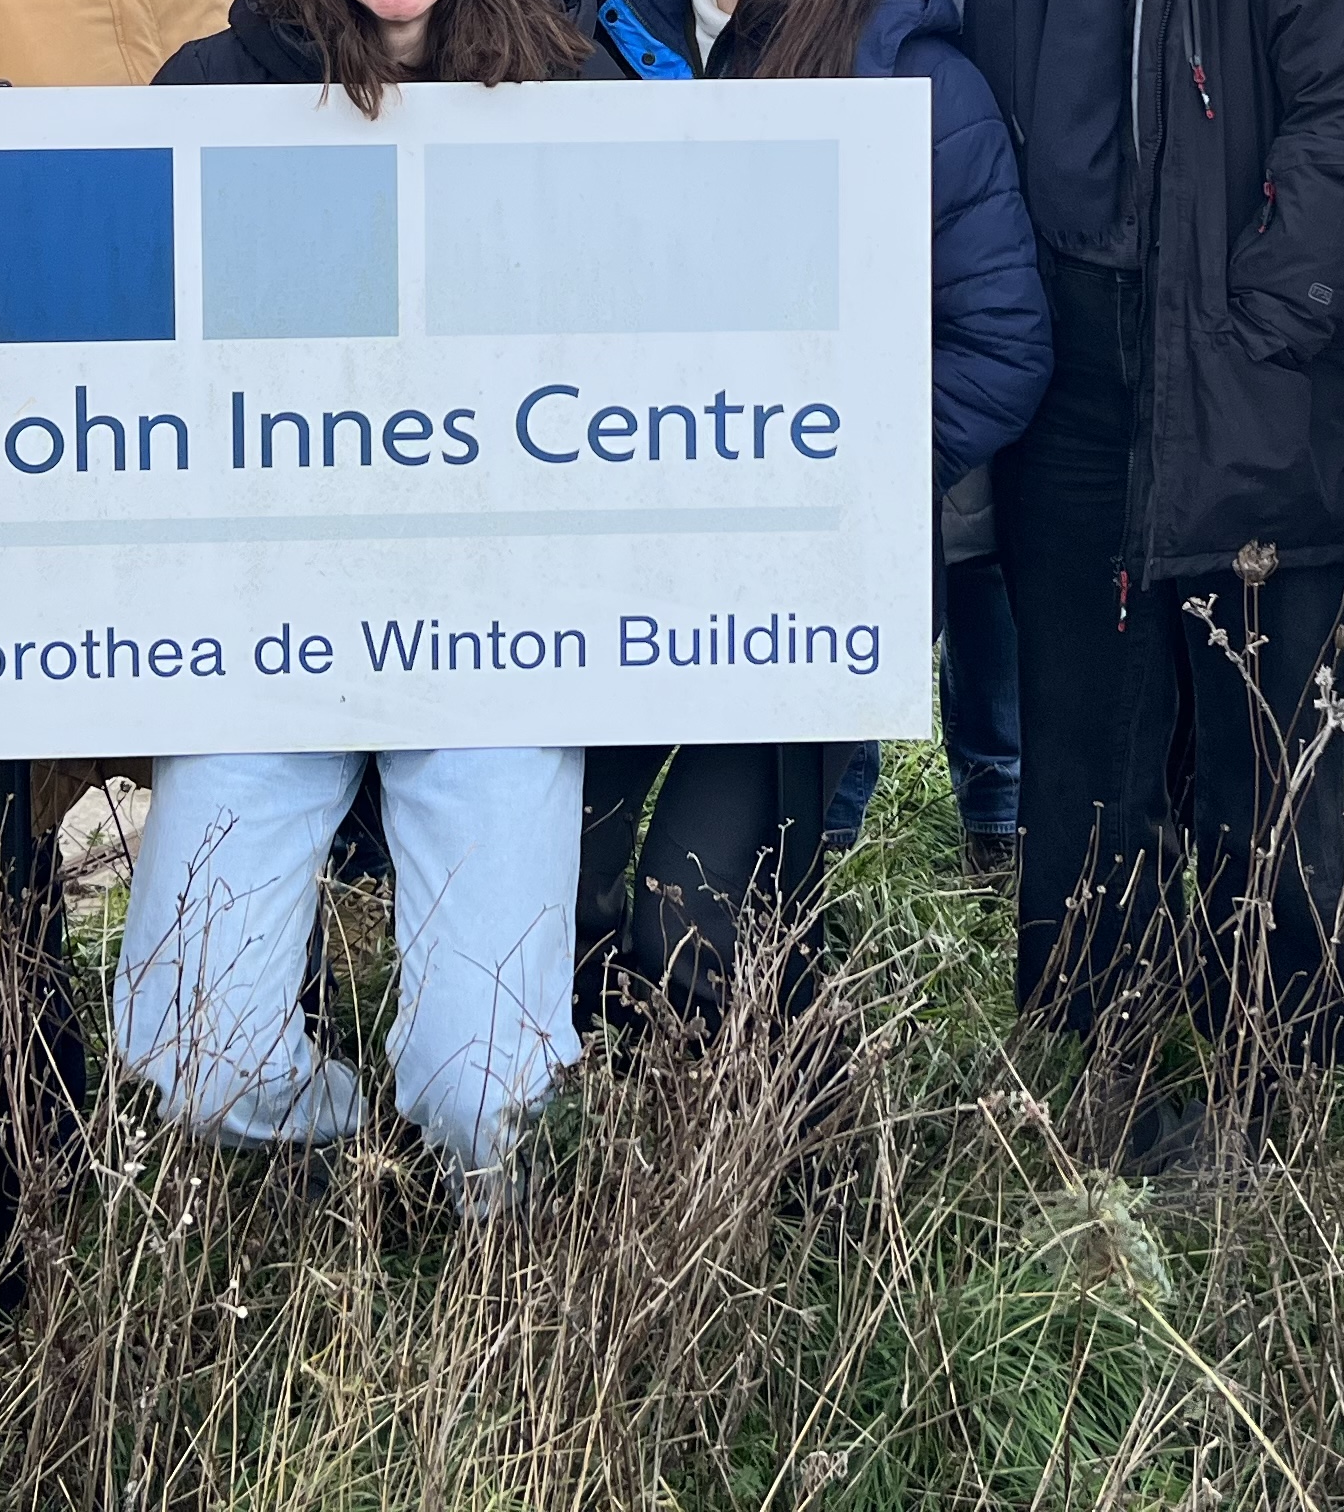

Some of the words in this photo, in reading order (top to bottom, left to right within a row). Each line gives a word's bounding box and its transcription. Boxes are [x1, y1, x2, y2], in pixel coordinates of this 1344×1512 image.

[231, 391, 480, 469] Innes
[515, 384, 841, 464] Centre
[254, 622, 334, 675] de
[360, 620, 586, 672] Winton
[619, 613, 879, 675] Building
